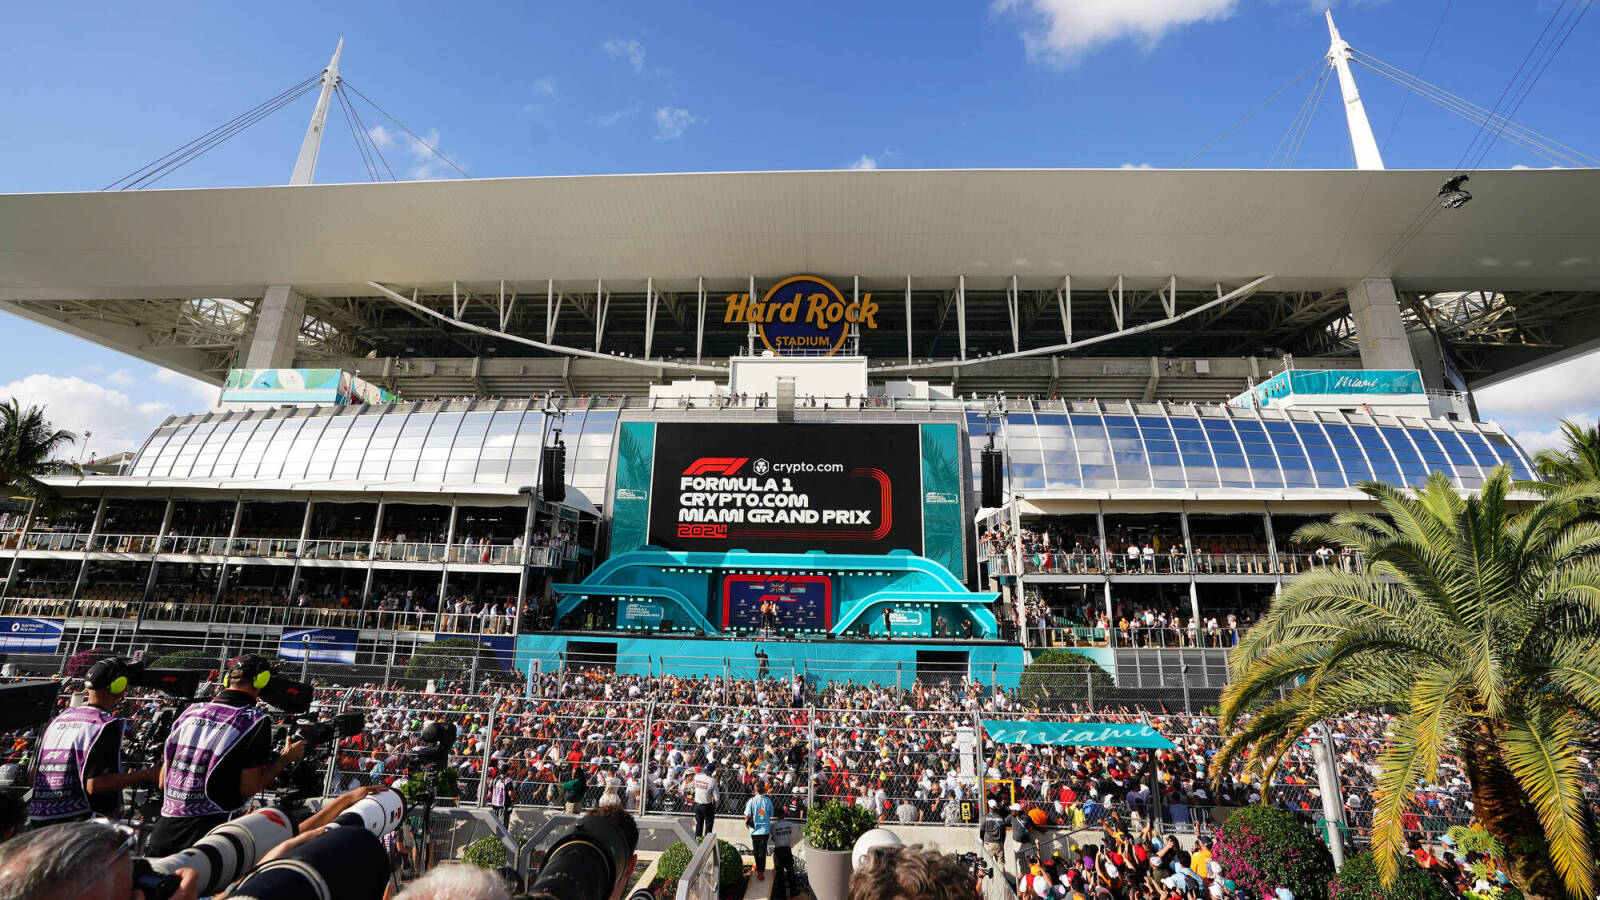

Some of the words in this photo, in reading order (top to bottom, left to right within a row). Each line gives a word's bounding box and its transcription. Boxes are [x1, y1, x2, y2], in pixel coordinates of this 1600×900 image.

[724, 293, 802, 323] Hard
[805, 293, 879, 330] Rock
[775, 336, 830, 346] STADIUM
[1334, 375, 1379, 389] Miami
[773, 461, 844, 474] crypto.com
[680, 477, 778, 491] FORMULA
[782, 478, 793, 491] 1
[679, 492, 808, 507] CRYPTO.COM
[678, 508, 744, 522] MIAMI
[747, 509, 819, 524] GRAND
[823, 510, 871, 524] PRIX
[677, 524, 727, 538] 2024
